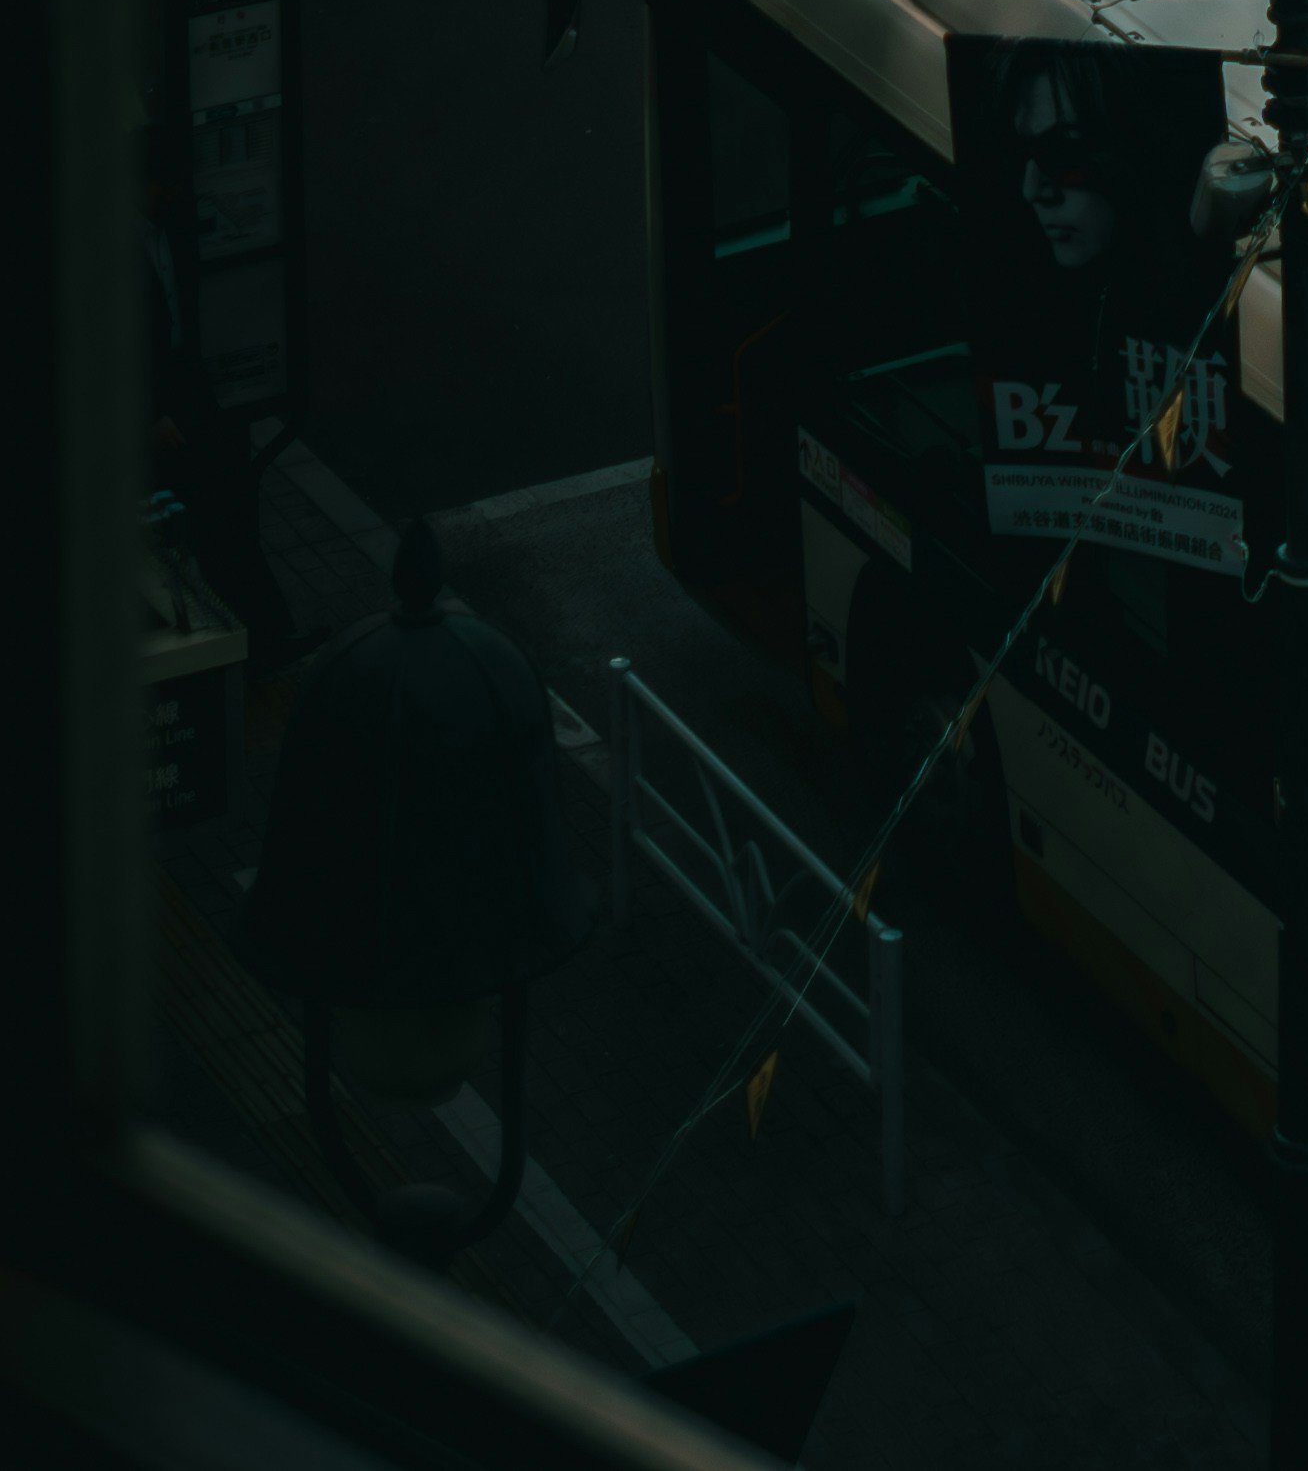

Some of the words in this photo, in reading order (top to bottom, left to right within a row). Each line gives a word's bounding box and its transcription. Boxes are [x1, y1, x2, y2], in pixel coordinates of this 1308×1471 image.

[992, 380, 1082, 452] B'z
[991, 473, 1056, 489] SHIBUYA
[1208, 501, 1238, 521] 2024
[1035, 635, 1111, 730] KEIO
[1145, 731, 1218, 825] BUS
